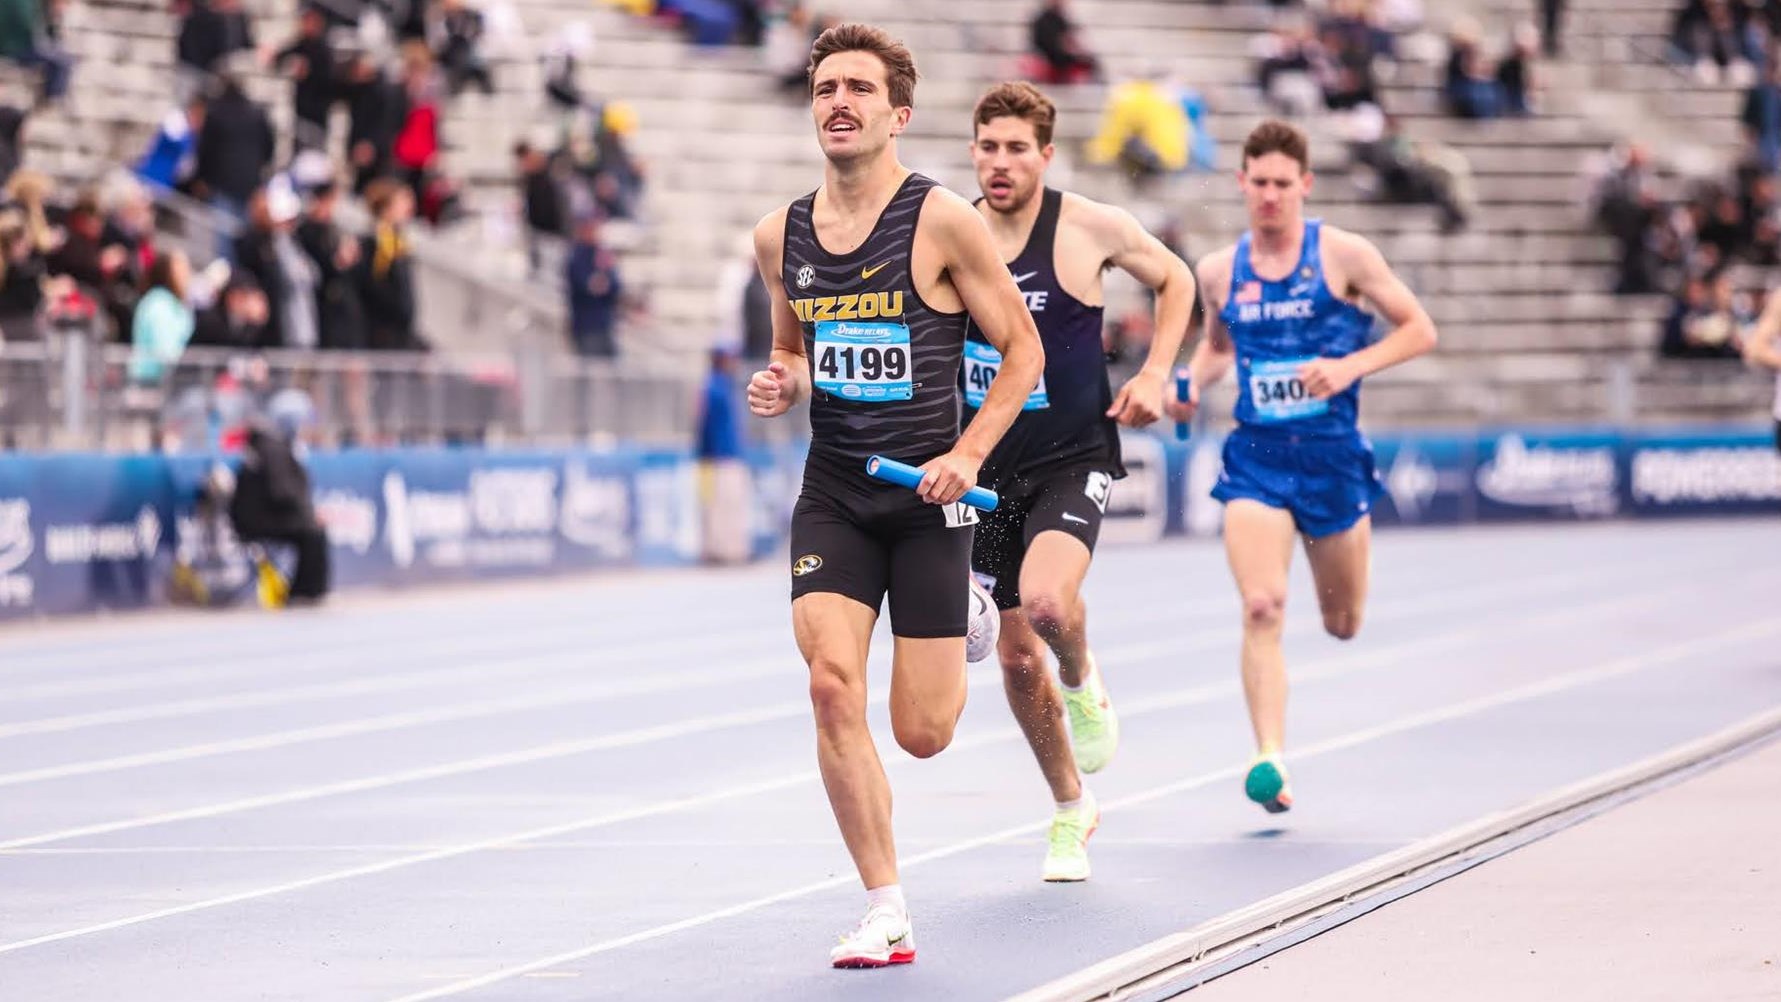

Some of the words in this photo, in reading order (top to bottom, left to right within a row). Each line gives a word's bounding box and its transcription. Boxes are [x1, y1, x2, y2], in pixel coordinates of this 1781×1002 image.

[1239, 304, 1261, 322] AIR
[1263, 299, 1315, 320] FORCE
[819, 346, 906, 381] 4199
[969, 363, 998, 391] 40
[1257, 378, 1313, 404] 340
